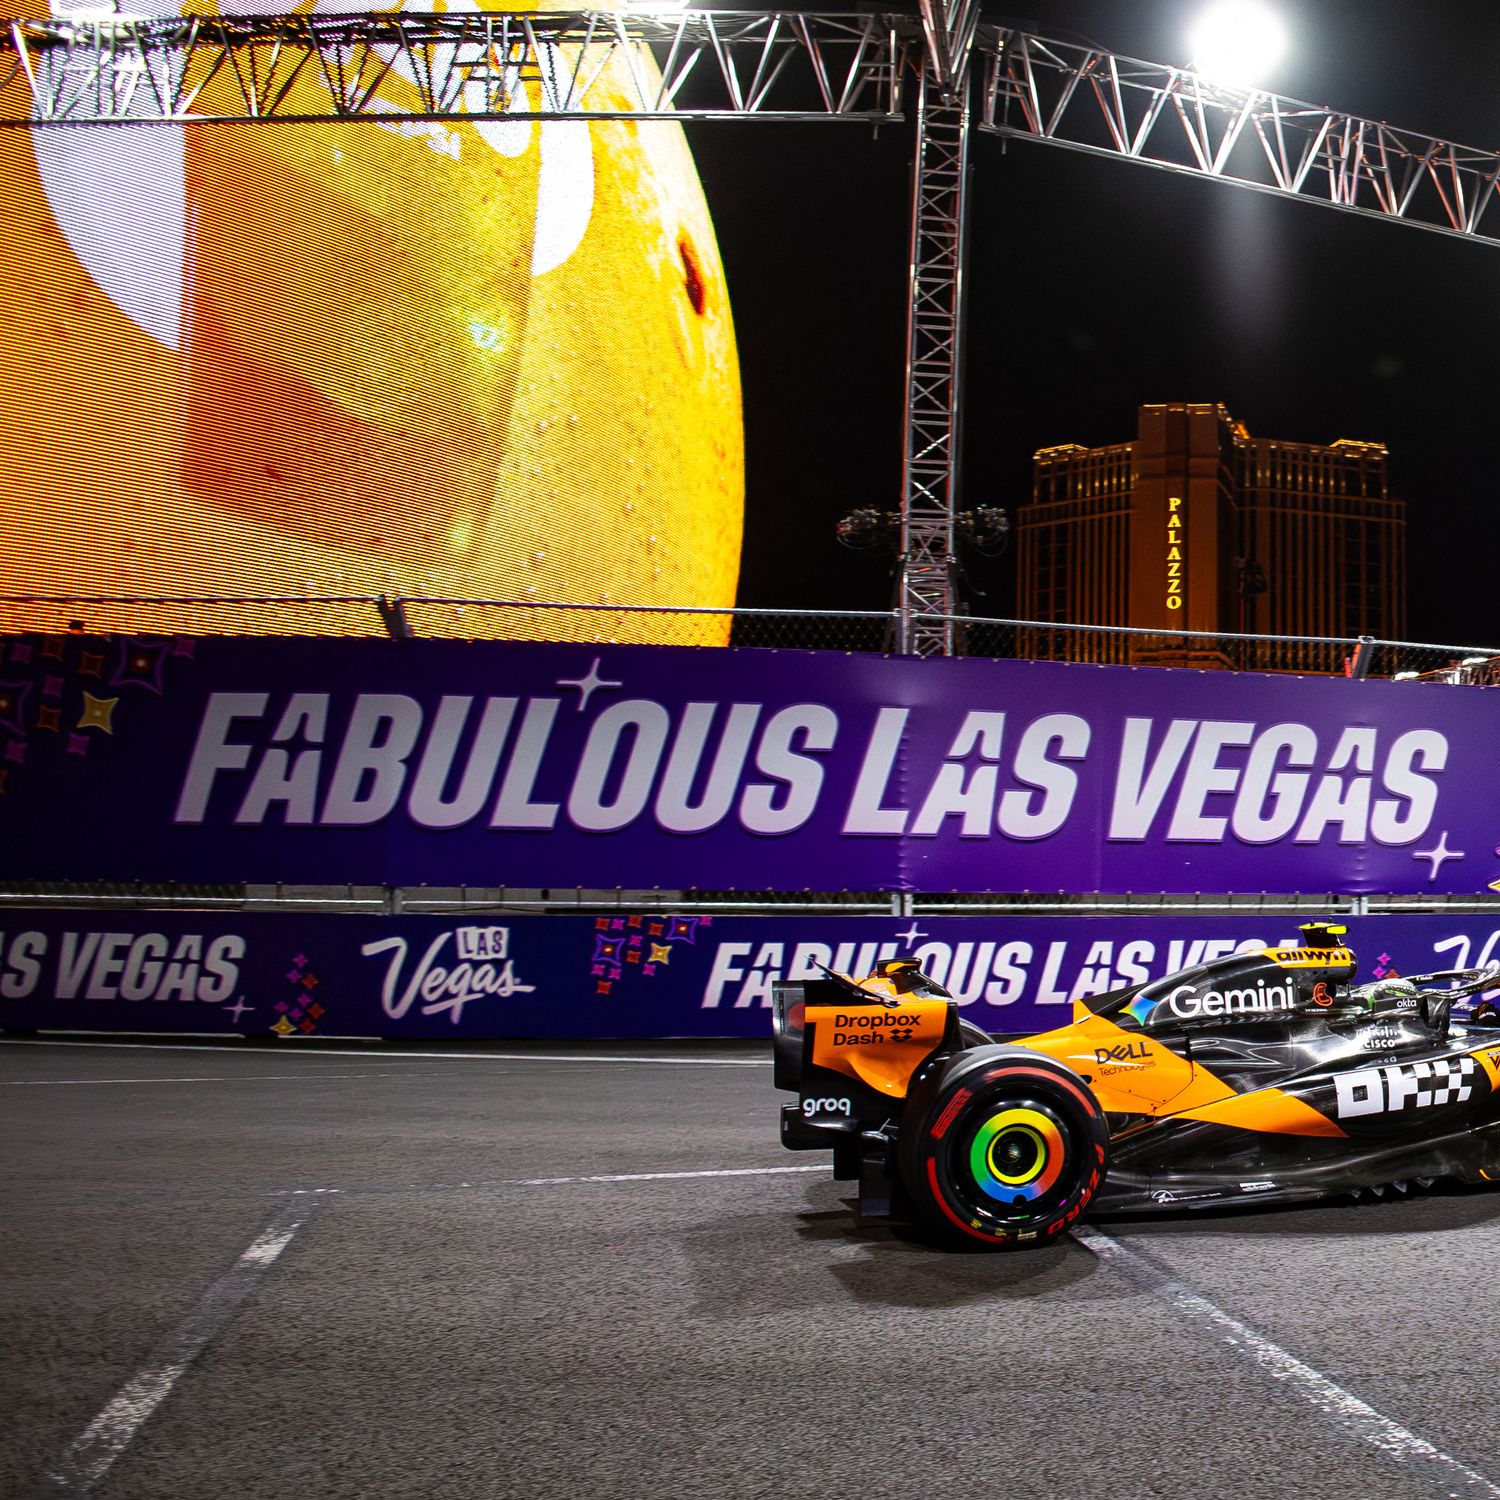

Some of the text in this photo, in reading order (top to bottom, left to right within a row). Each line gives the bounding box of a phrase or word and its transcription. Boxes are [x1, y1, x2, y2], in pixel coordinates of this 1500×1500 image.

[1166, 498, 1182, 609] PALAZZO
[174, 692, 1448, 845] FABULOUS LAS VEGAS
[461, 929, 505, 957] LAS
[54, 931, 247, 1003] VEGAS
[1276, 950, 1347, 965] allwyn
[361, 932, 536, 1025] Vegas
[704, 942, 1033, 1005] FABUOUS
[1035, 940, 1155, 1005] LAS
[1169, 977, 1294, 1018] Gemini
[1396, 997, 1417, 1008] okta
[835, 1013, 922, 1030] Dropbox
[833, 1031, 884, 1046] Dash
[1095, 1042, 1153, 1065] DELL
[802, 1097, 851, 1117] groq
